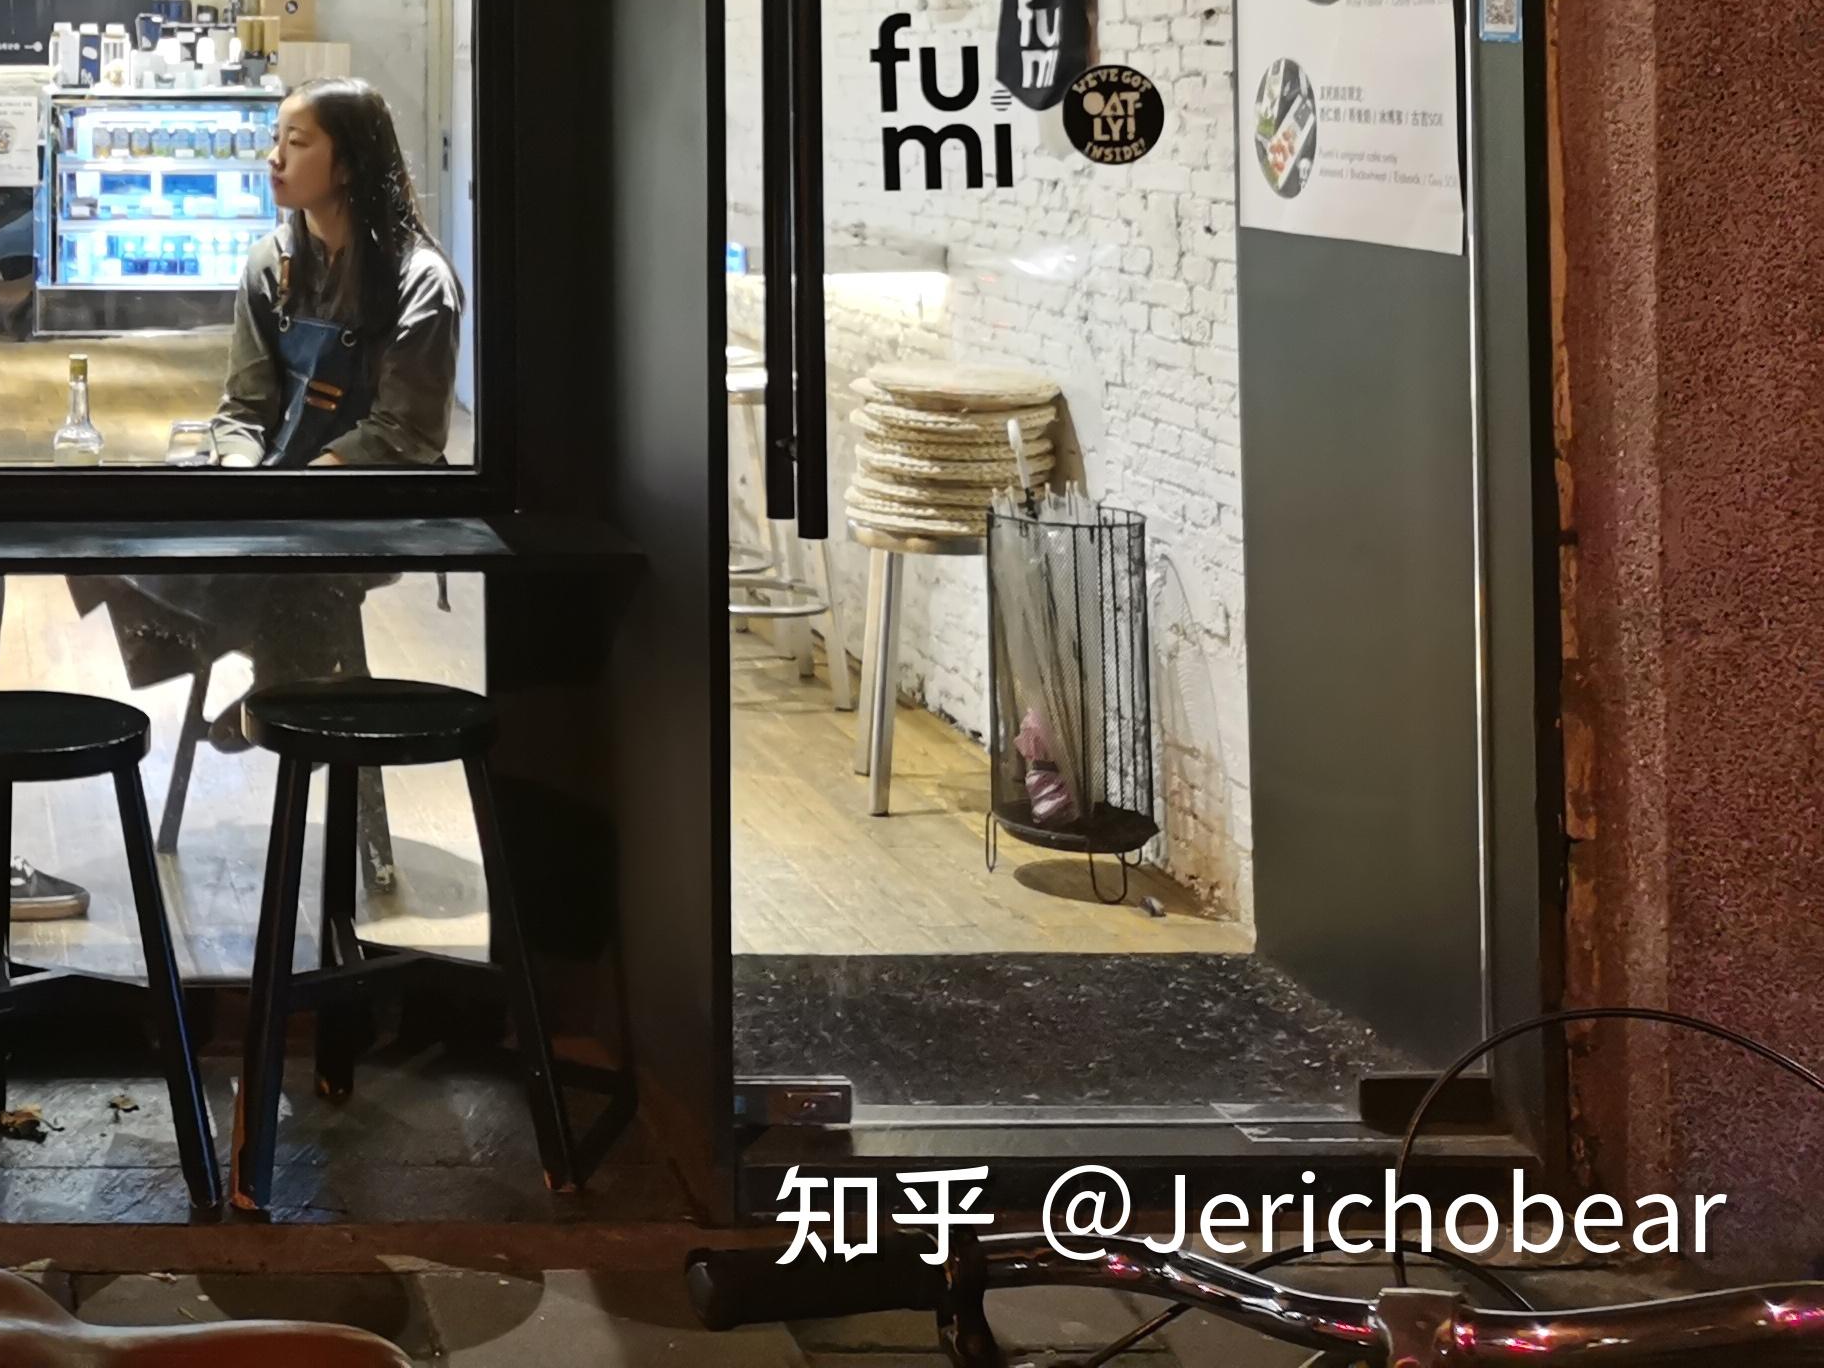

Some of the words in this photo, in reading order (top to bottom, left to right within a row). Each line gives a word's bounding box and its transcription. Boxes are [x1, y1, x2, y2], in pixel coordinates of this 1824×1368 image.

[870, 13, 980, 113] fu
[1072, 68, 1119, 94] WE'VE
[1121, 69, 1153, 93] GOT
[881, 90, 1014, 192] mi
[1093, 116, 1137, 142] LY!
[1084, 138, 1147, 162] INSIDE!
